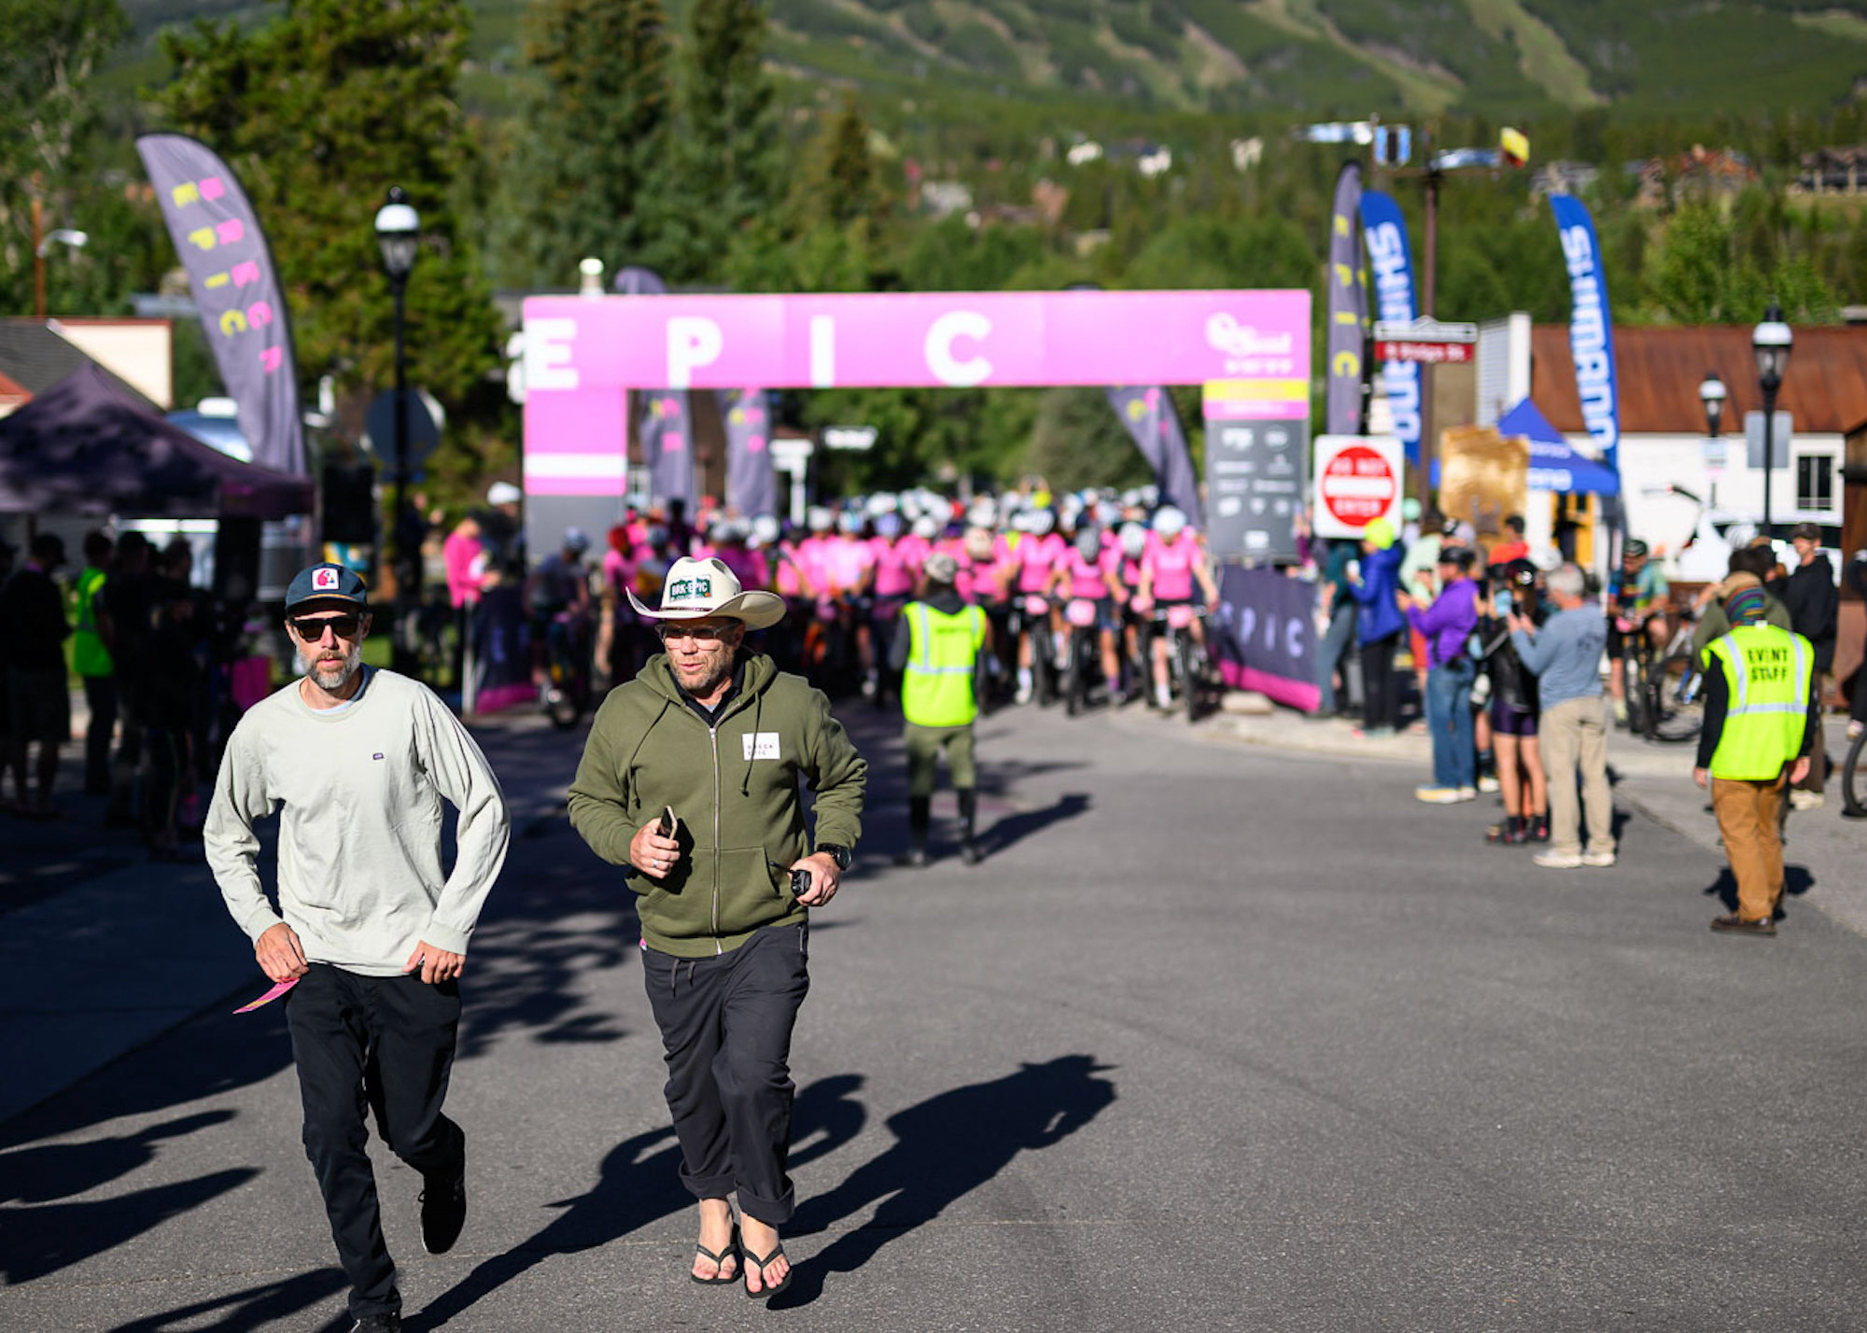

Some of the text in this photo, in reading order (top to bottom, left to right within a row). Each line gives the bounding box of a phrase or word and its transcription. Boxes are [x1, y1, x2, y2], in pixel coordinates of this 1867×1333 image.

[172, 181, 247, 338] EPIC
[1559, 223, 1616, 450] SHIMANO
[525, 310, 995, 390] EPIC
[1356, 457, 1386, 475] NOT
[1333, 498, 1381, 516] ENTER
[1747, 649, 1788, 663] EVENT
[1751, 666, 1788, 683] STAFF
